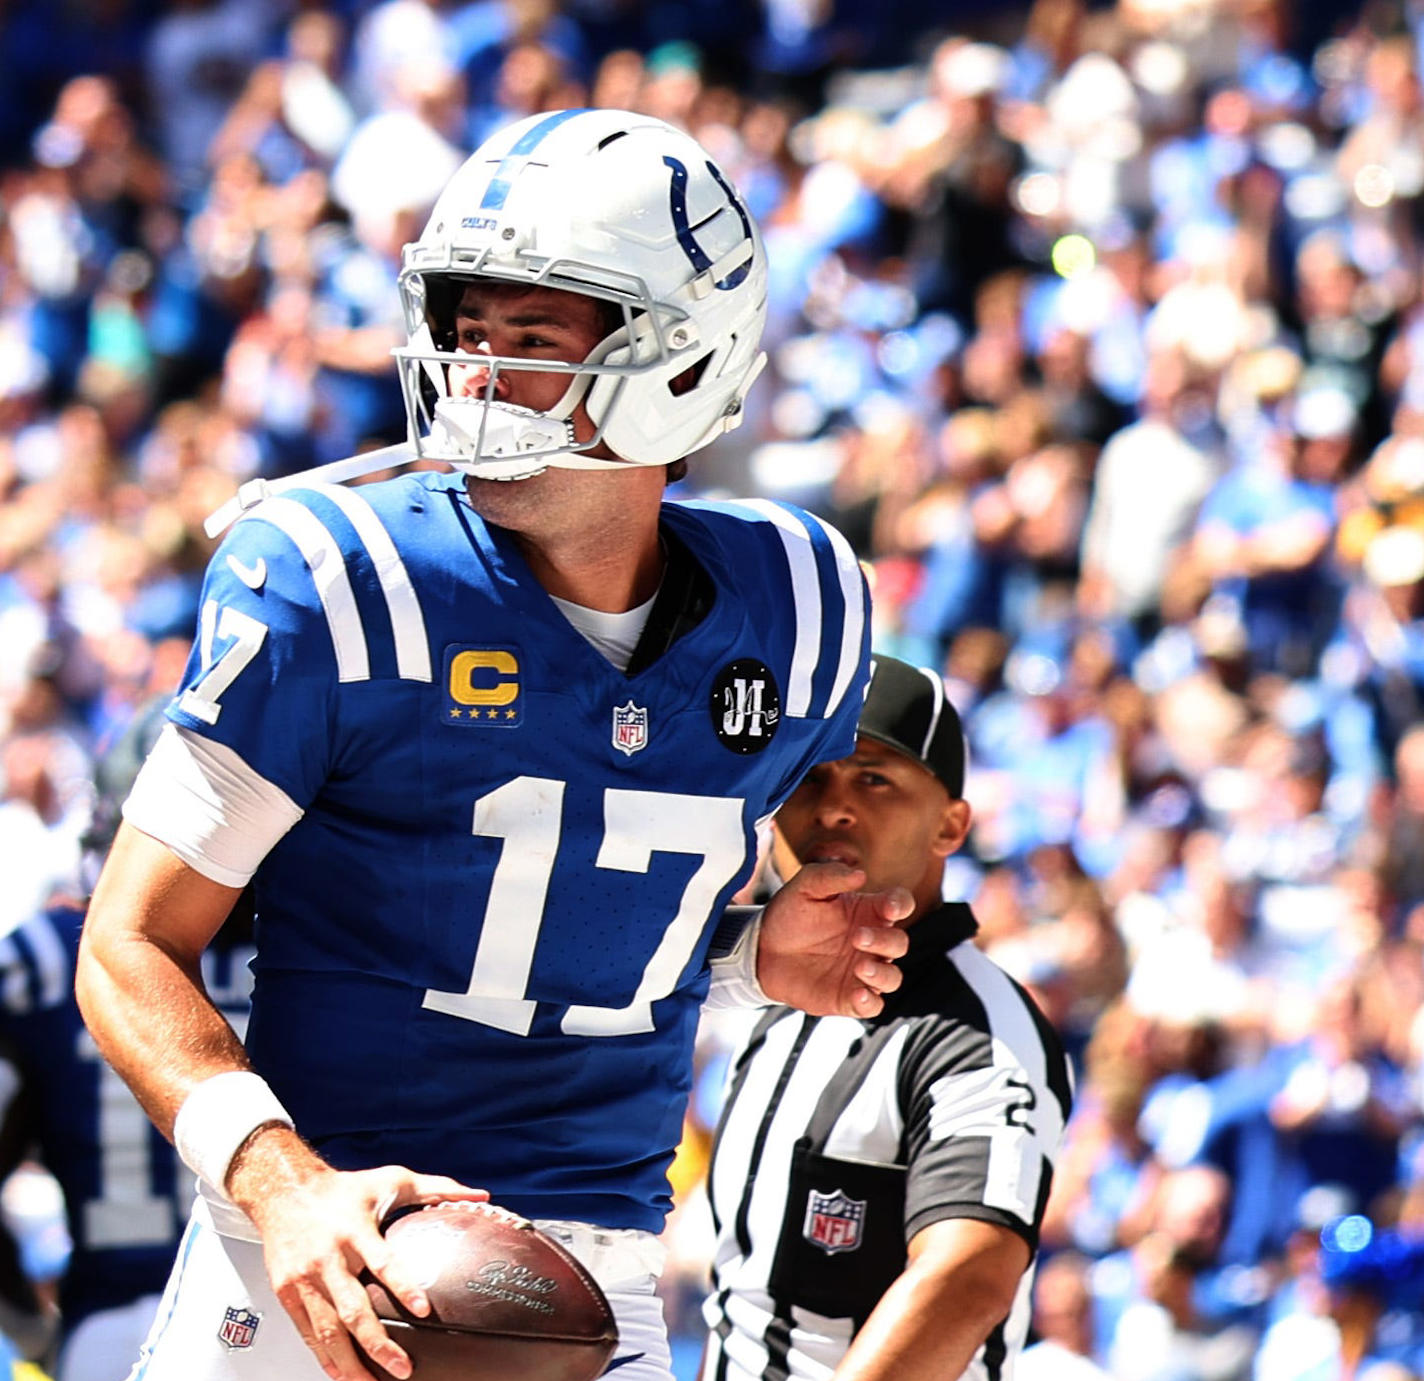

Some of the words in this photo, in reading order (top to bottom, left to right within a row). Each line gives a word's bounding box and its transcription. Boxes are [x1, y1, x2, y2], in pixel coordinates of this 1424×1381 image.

[173, 599, 269, 726] 17
[449, 650, 519, 706] C
[619, 725, 644, 744] NFL
[421, 775, 746, 1037] 17
[1005, 1077, 1037, 1137] 2
[812, 1214, 857, 1246] NFL
[222, 1321, 250, 1344] NFL
